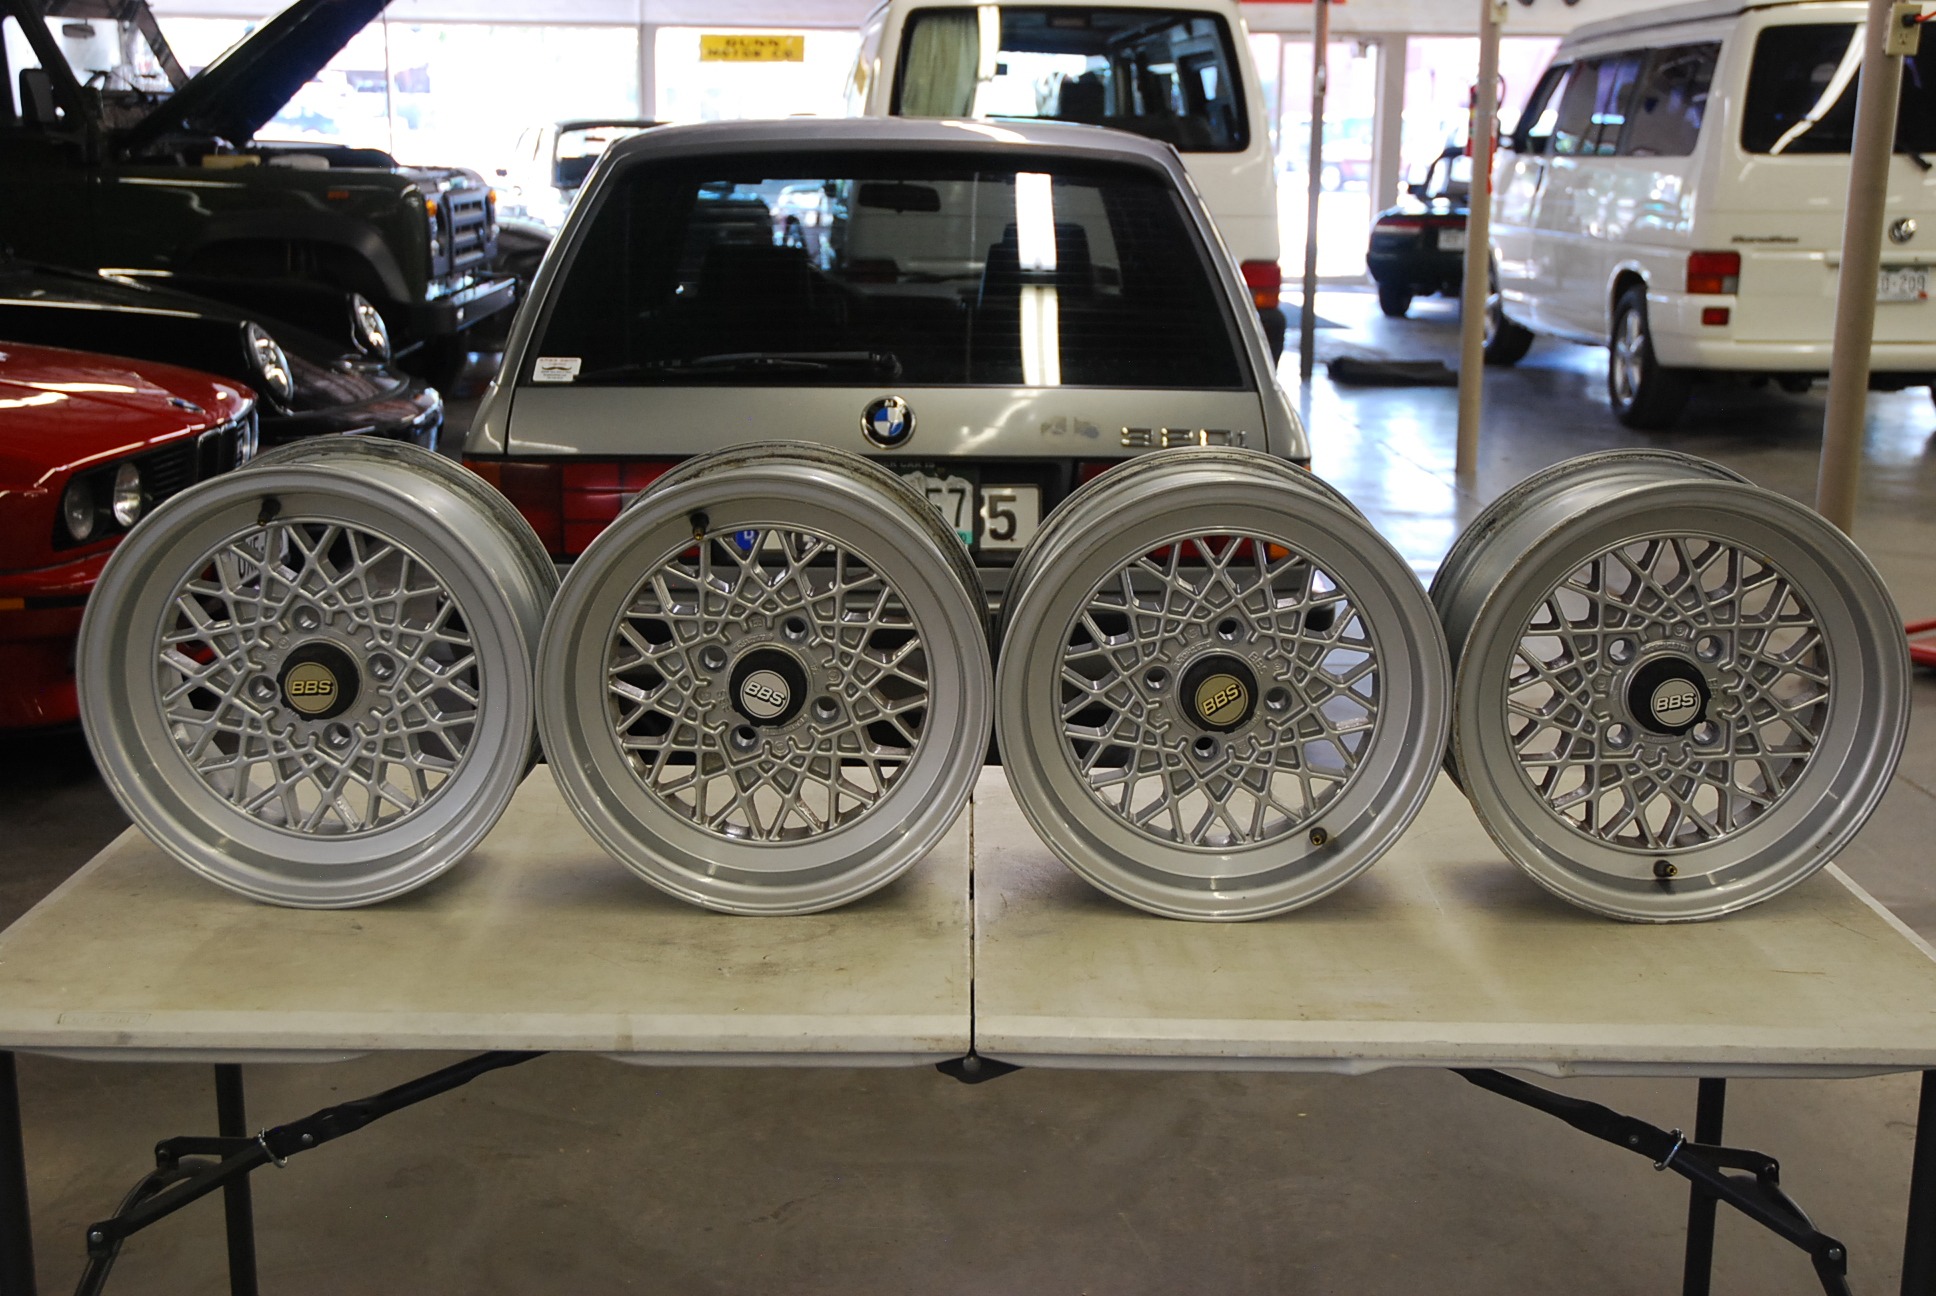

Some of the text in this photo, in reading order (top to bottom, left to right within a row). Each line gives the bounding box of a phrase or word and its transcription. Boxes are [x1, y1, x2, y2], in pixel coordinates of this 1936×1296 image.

[291, 680, 333, 696] BBS
[744, 681, 786, 708] BBS
[1202, 683, 1241, 717] BBS
[1656, 692, 1697, 713] BBS
